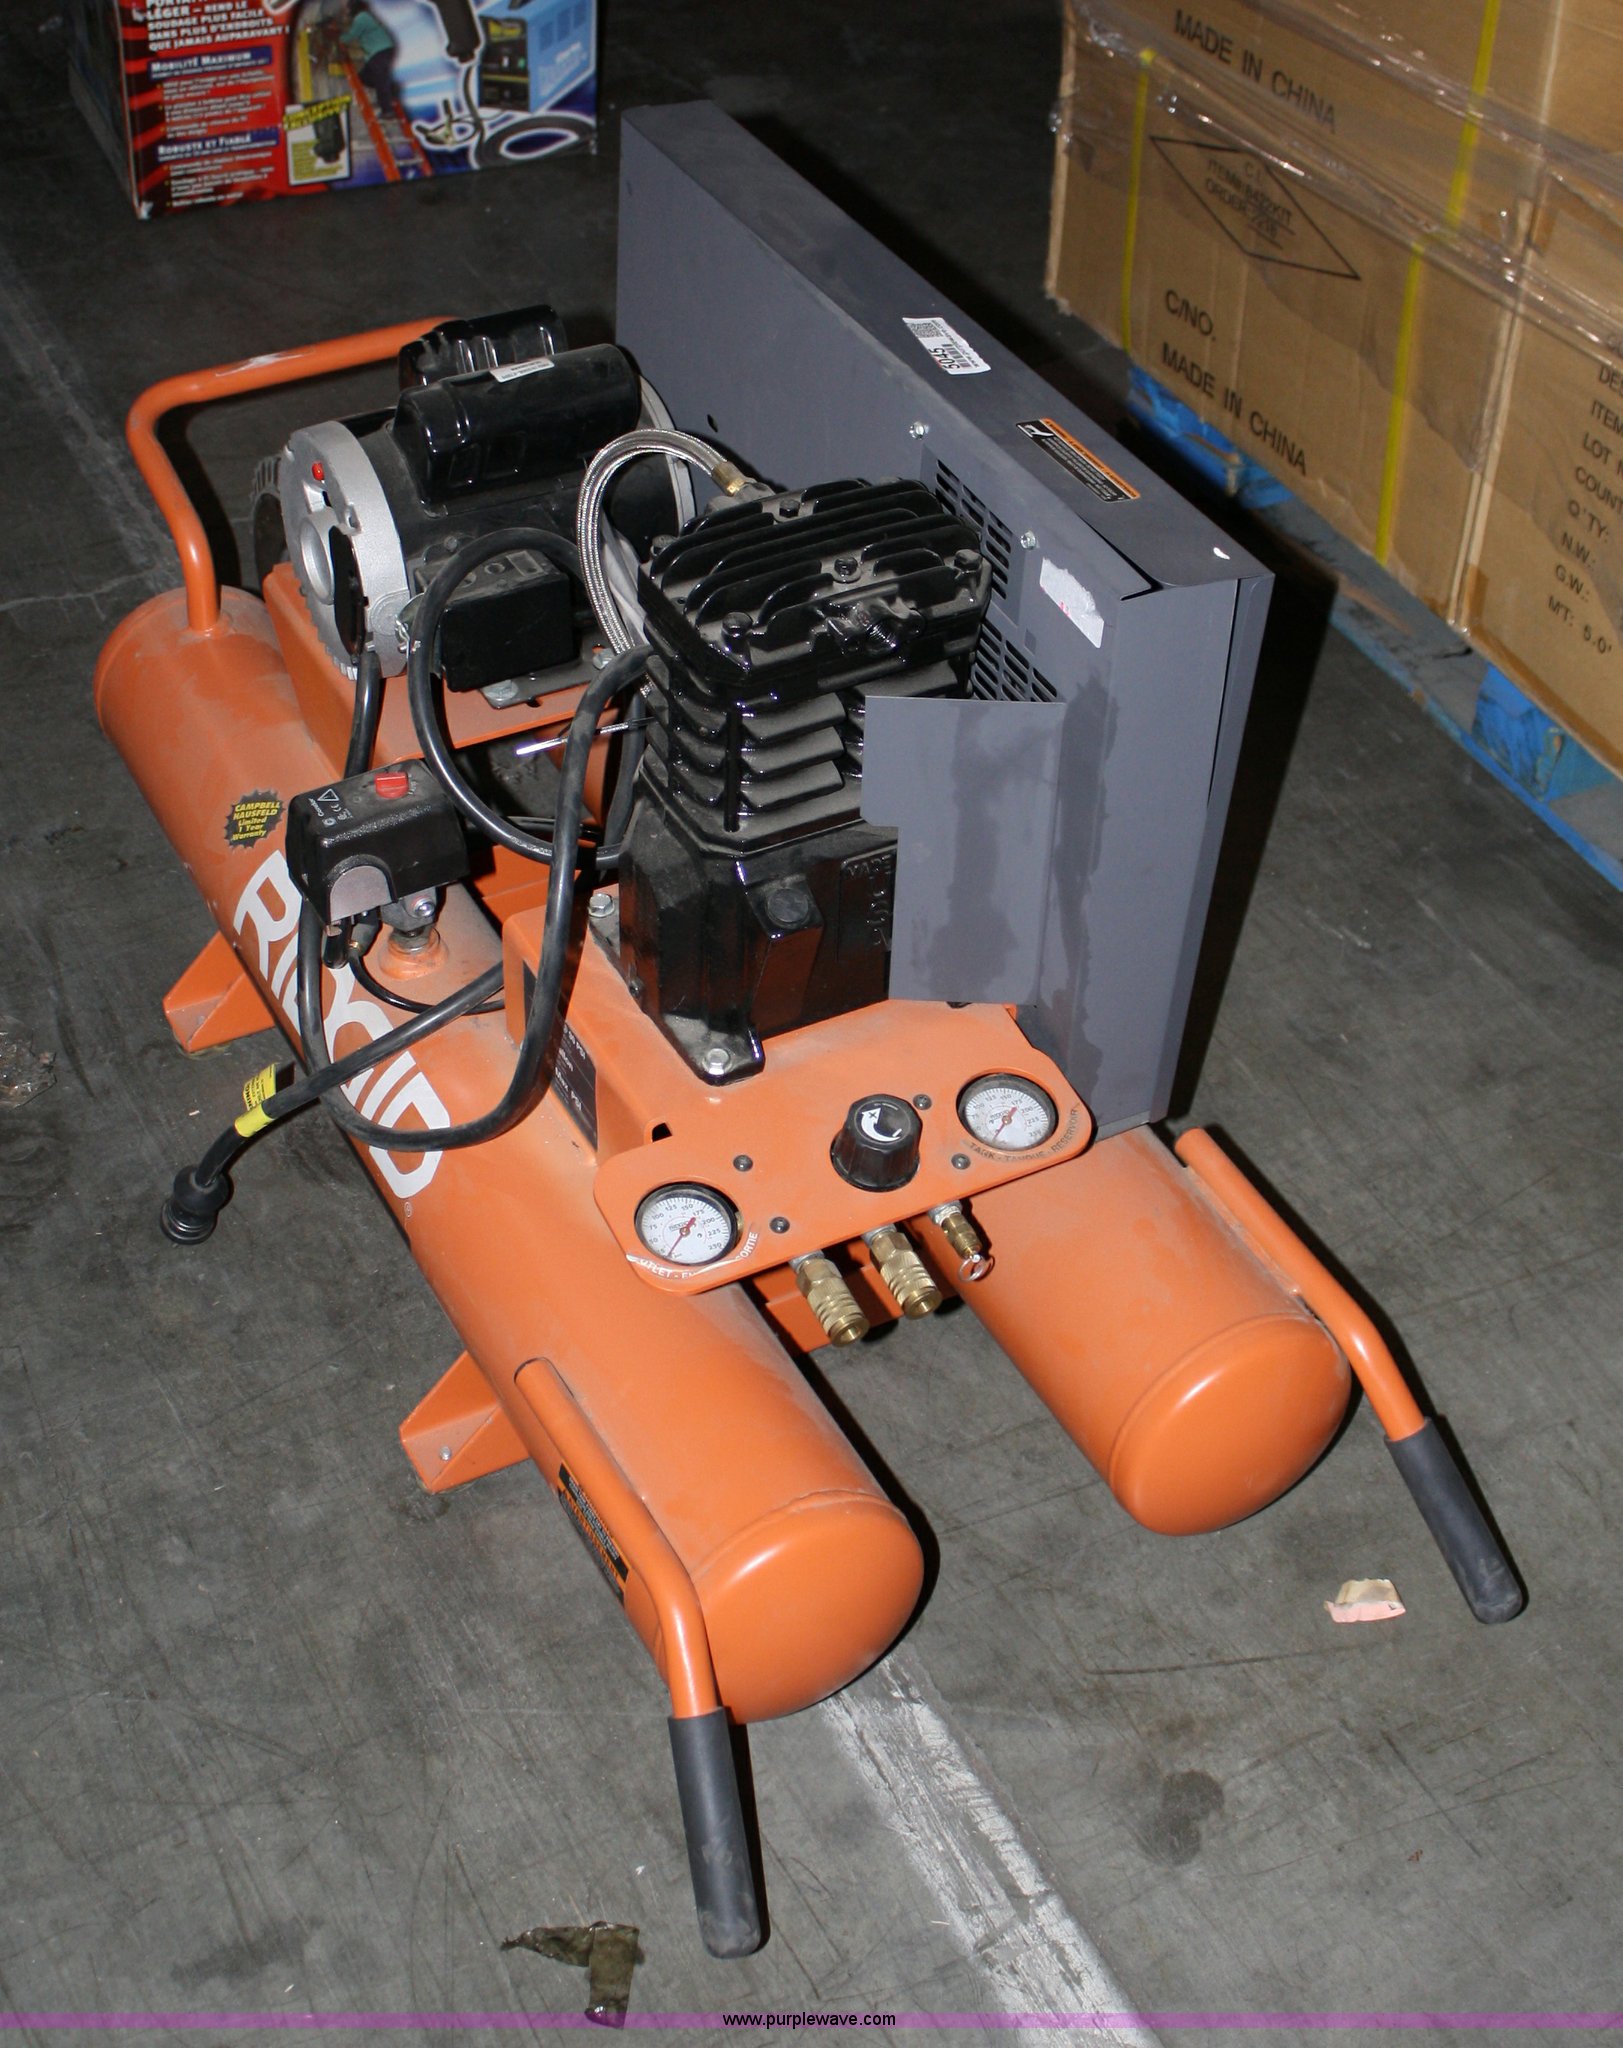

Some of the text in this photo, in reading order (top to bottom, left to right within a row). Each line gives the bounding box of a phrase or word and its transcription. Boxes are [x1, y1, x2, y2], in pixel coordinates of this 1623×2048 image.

[236, 1, 247, 9] LE
[148, 9, 264, 31] SOUDAGE PLUS FACILE
[149, 30, 178, 41] DANS
[180, 25, 207, 37] PLUS
[149, 40, 171, 51] QUE
[174, 35, 212, 48] JAMAIS
[215, 26, 283, 42] AUPARAVANT
[1174, 9, 1335, 135] MADE IN CHINA
[1165, 289, 1216, 341] C/NO.
[1162, 342, 1306, 476] MADE IN CHINA
[1583, 432, 1612, 465] LOT
[233, 809, 278, 820] HAUSFELD
[235, 801, 280, 812] CAMPBELL
[238, 816, 268, 827] Limited
[246, 824, 264, 832] Year
[232, 830, 267, 841] Warranty
[233, 848, 451, 1199] RIDGID
